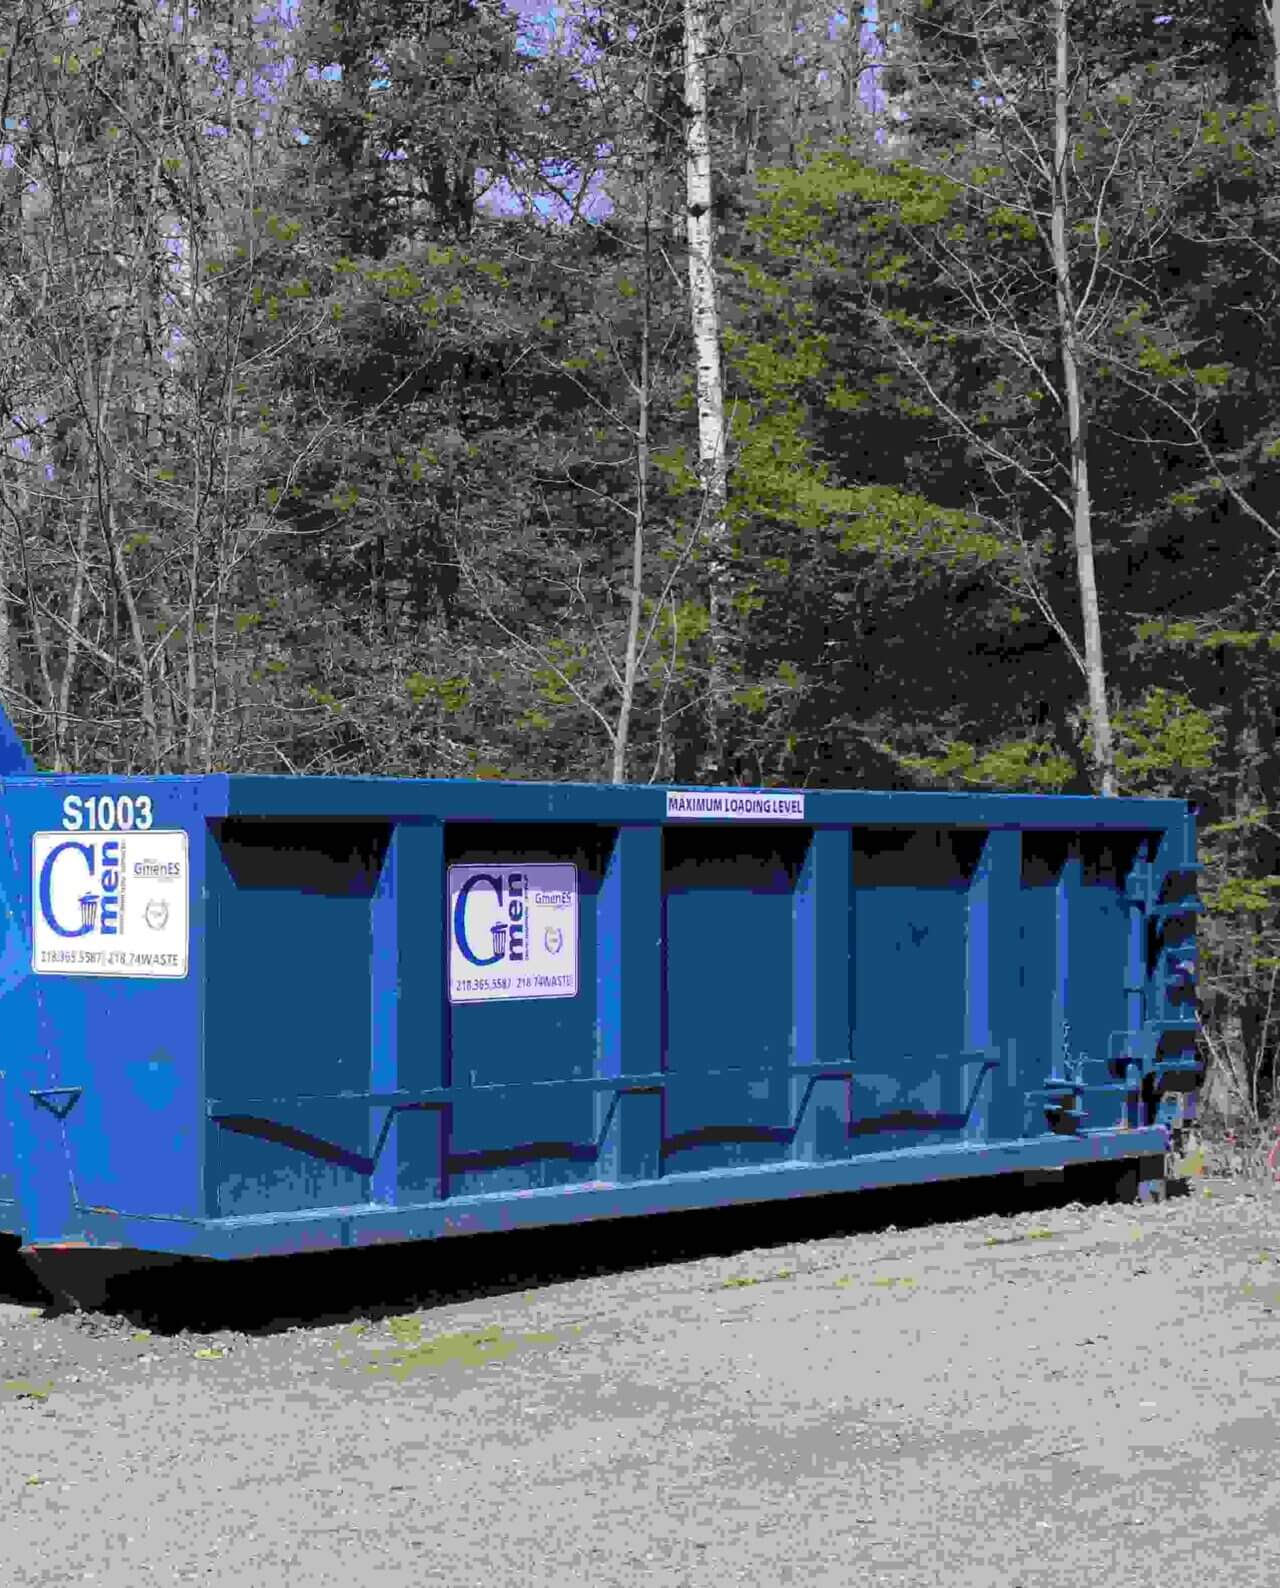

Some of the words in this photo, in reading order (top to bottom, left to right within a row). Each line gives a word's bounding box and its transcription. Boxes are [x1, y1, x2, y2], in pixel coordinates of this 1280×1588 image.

[62, 795, 153, 830] S1003
[670, 798, 722, 812] MAXIMUM
[725, 799, 770, 814] LOADING
[773, 800, 803, 814] LEVEL
